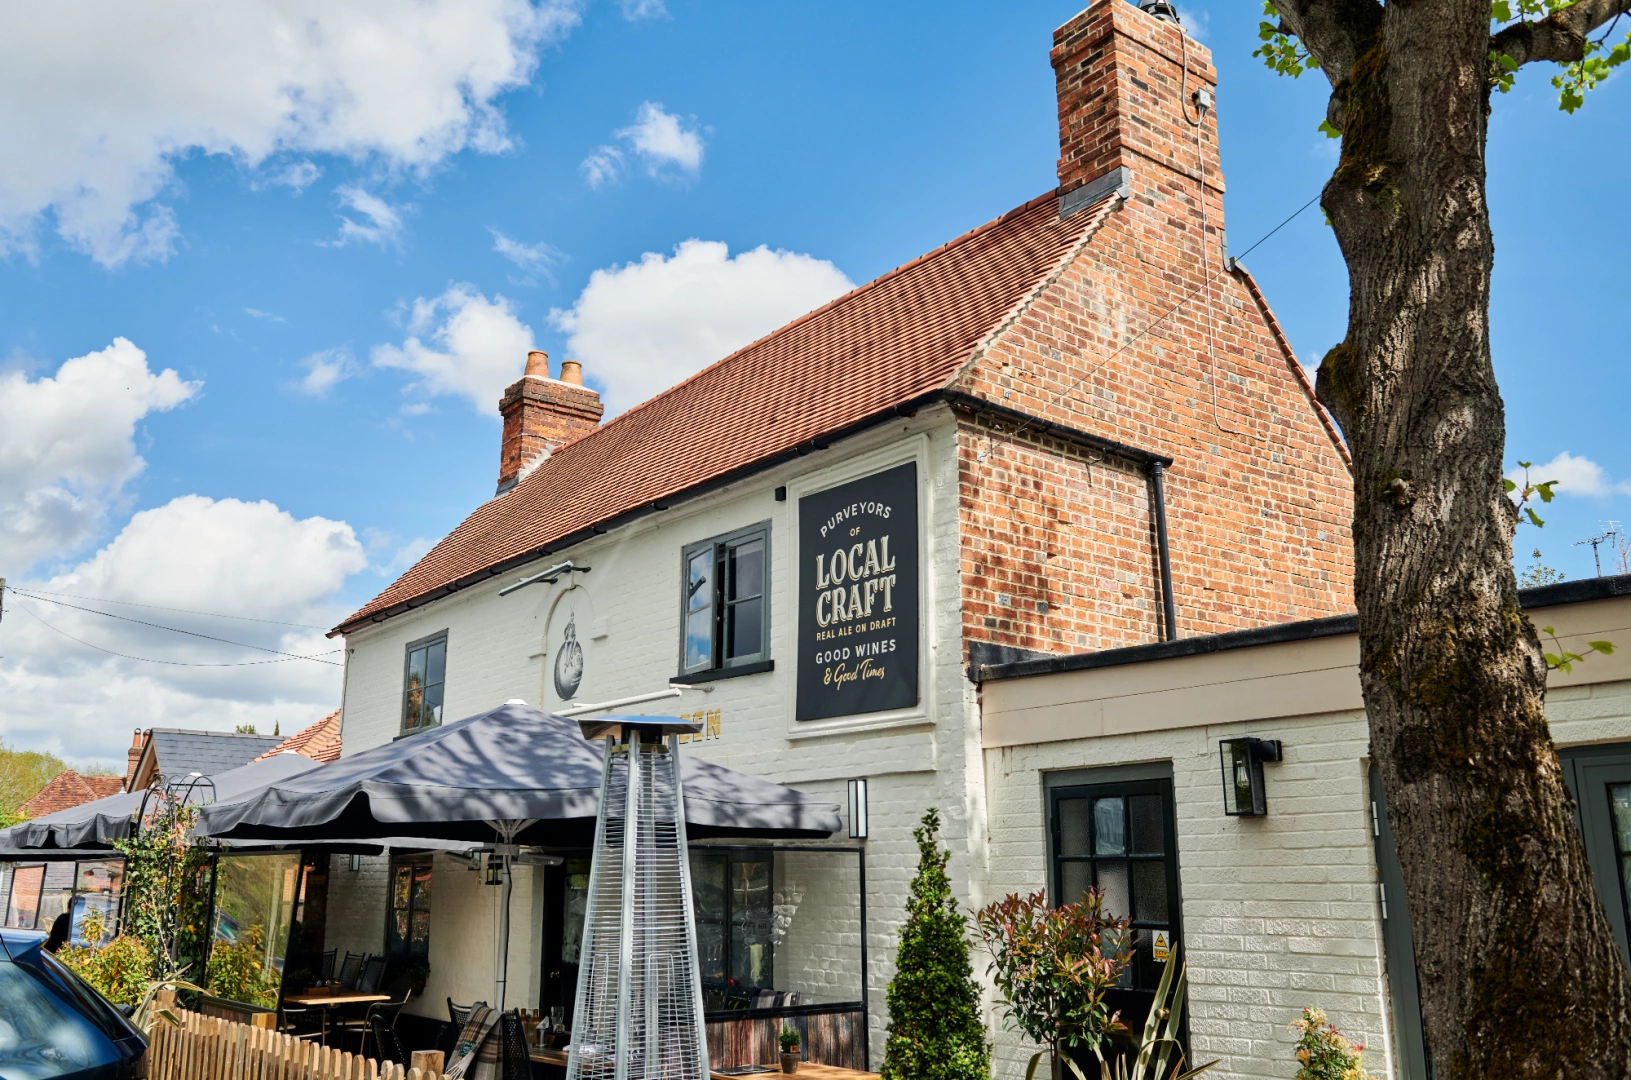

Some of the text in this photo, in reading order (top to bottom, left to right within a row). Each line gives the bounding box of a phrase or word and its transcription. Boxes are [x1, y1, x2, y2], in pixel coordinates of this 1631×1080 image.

[820, 501, 892, 538] PURVEYORS
[849, 526, 861, 537] OF
[815, 534, 896, 590] LOCAL
[815, 573, 896, 628] CRAFT
[816, 616, 896, 641] REAL ALE ON DRAFT
[815, 639, 896, 665] GOOD WINES
[823, 658, 885, 691] & Good Times
